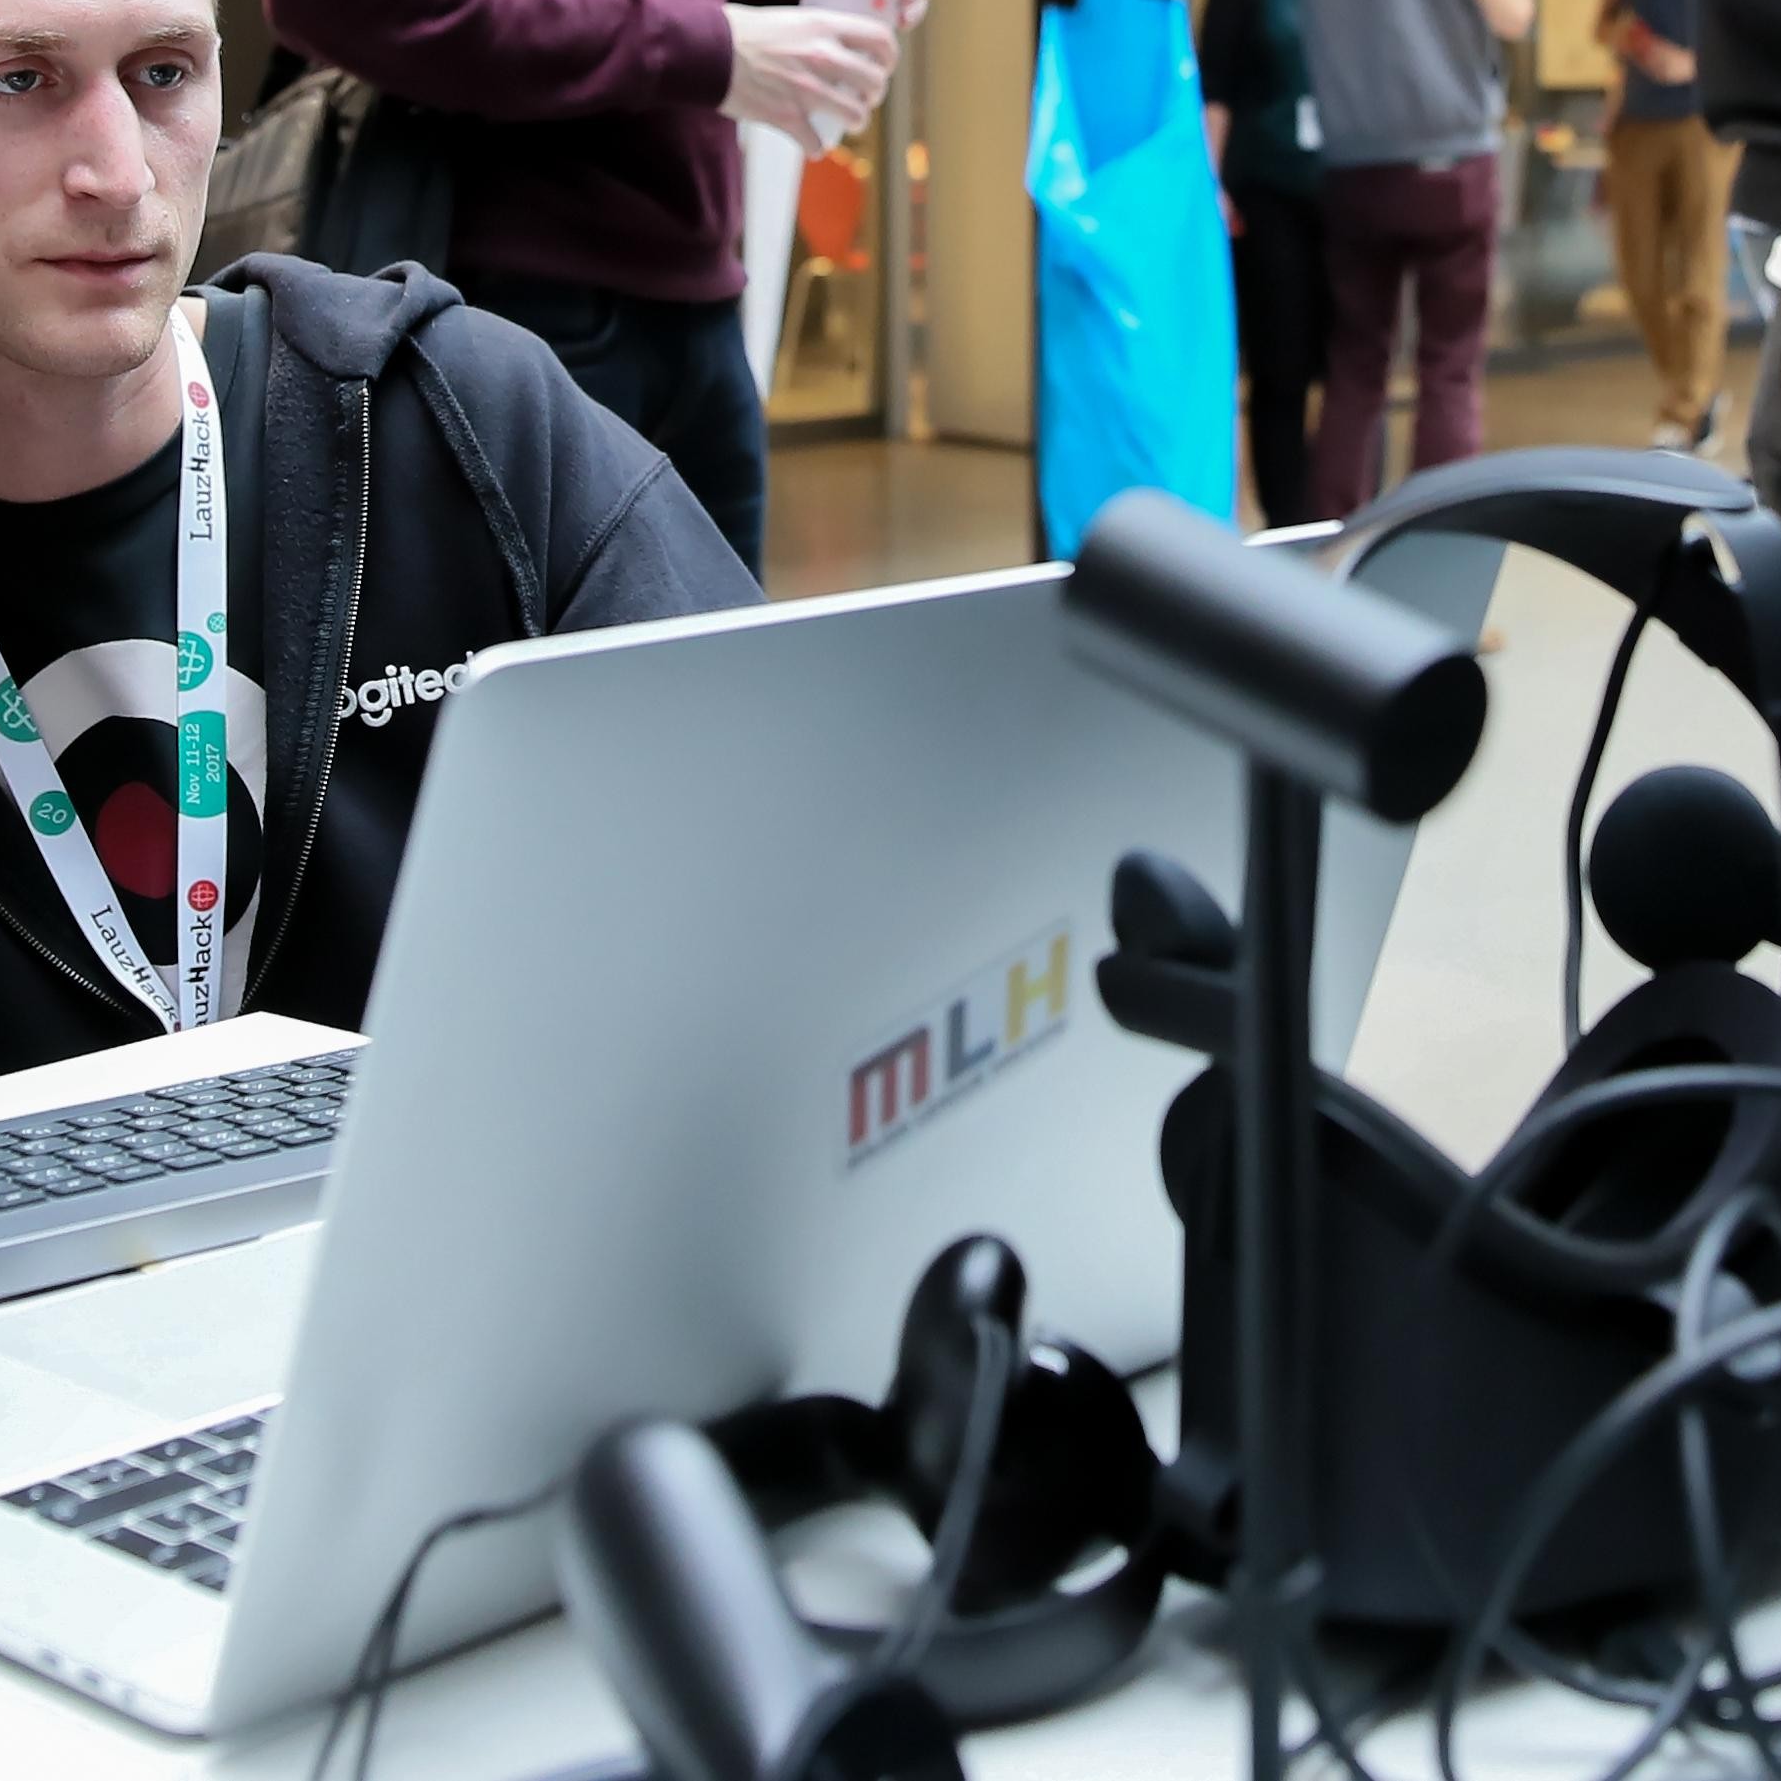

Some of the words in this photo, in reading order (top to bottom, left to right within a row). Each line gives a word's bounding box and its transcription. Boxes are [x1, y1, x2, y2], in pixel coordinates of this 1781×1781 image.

[189, 410, 211, 542] LauzHack
[337, 650, 478, 727] ogitec
[185, 723, 200, 766] 11-12
[206, 743, 221, 782] 2017
[186, 773, 201, 804] Nov
[90, 904, 178, 1023] LauzHack
[183, 913, 213, 1027] uzHack
